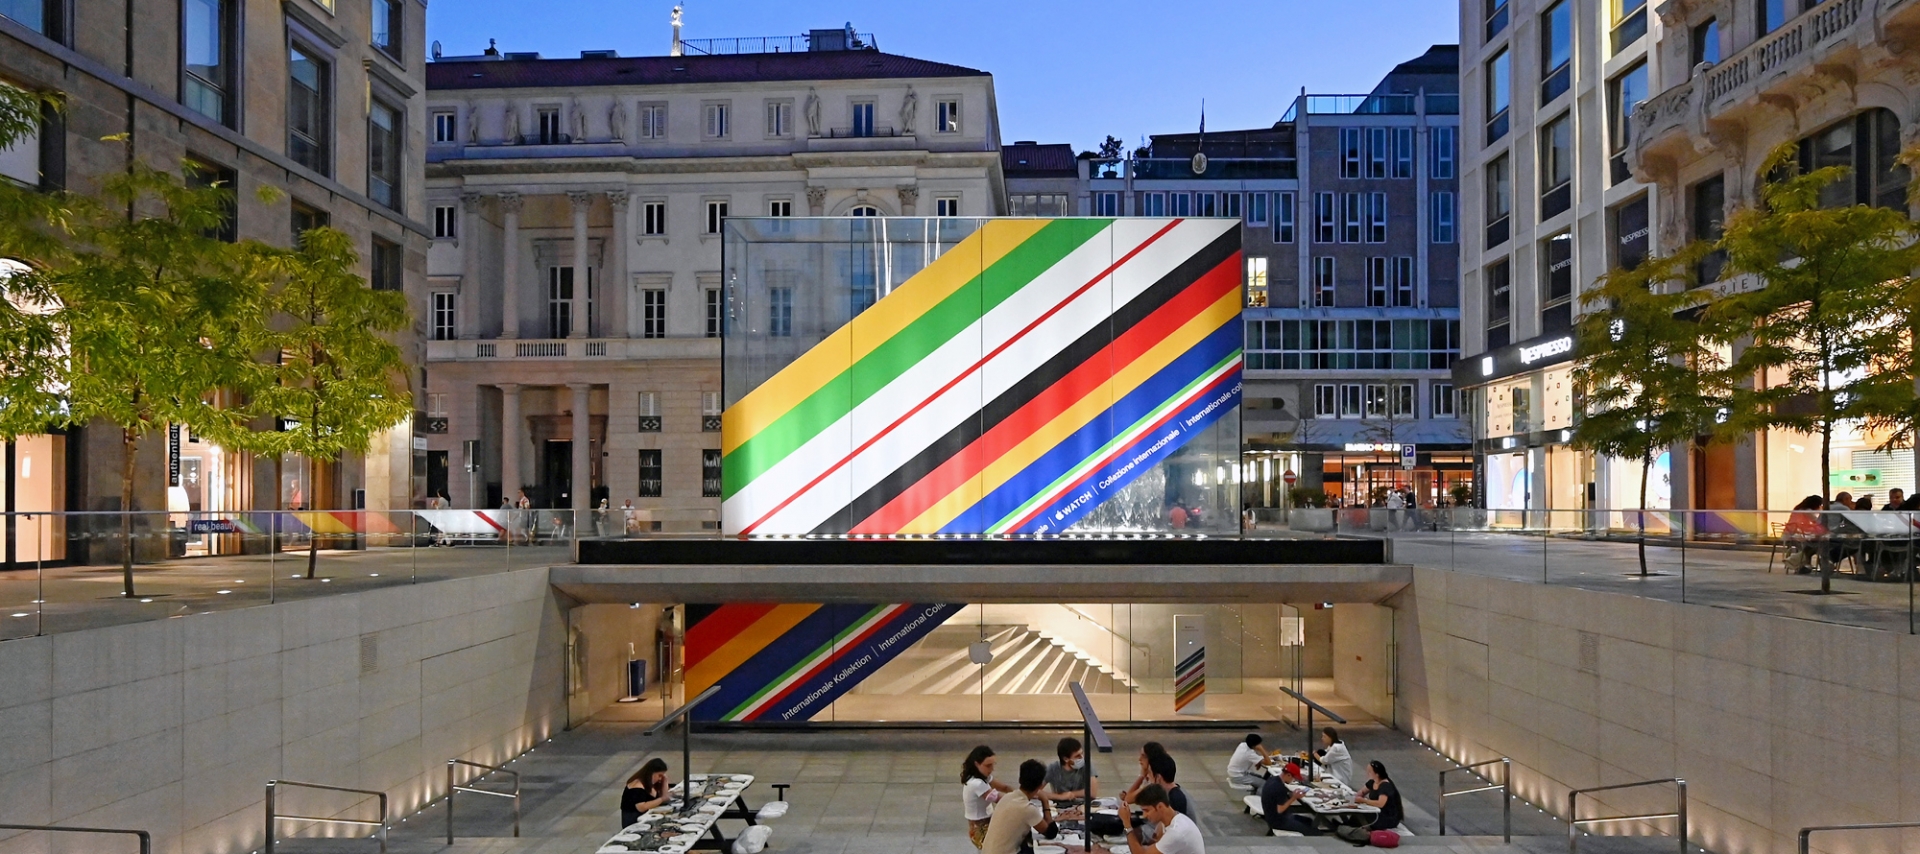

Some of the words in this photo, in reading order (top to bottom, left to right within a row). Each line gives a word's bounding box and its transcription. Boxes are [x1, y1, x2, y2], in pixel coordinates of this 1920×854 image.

[1519, 337, 1571, 364] NESPRESSO
[170, 423, 178, 483] authenticit
[1062, 490, 1093, 515] WATCH
[1099, 462, 1135, 489] Collezione
[1185, 392, 1232, 426] Internationale
[1405, 446, 1412, 456] P
[210, 521, 236, 532] beauty
[781, 681, 834, 720] Internationale
[832, 653, 872, 684] Kollektion
[878, 613, 927, 651] International
